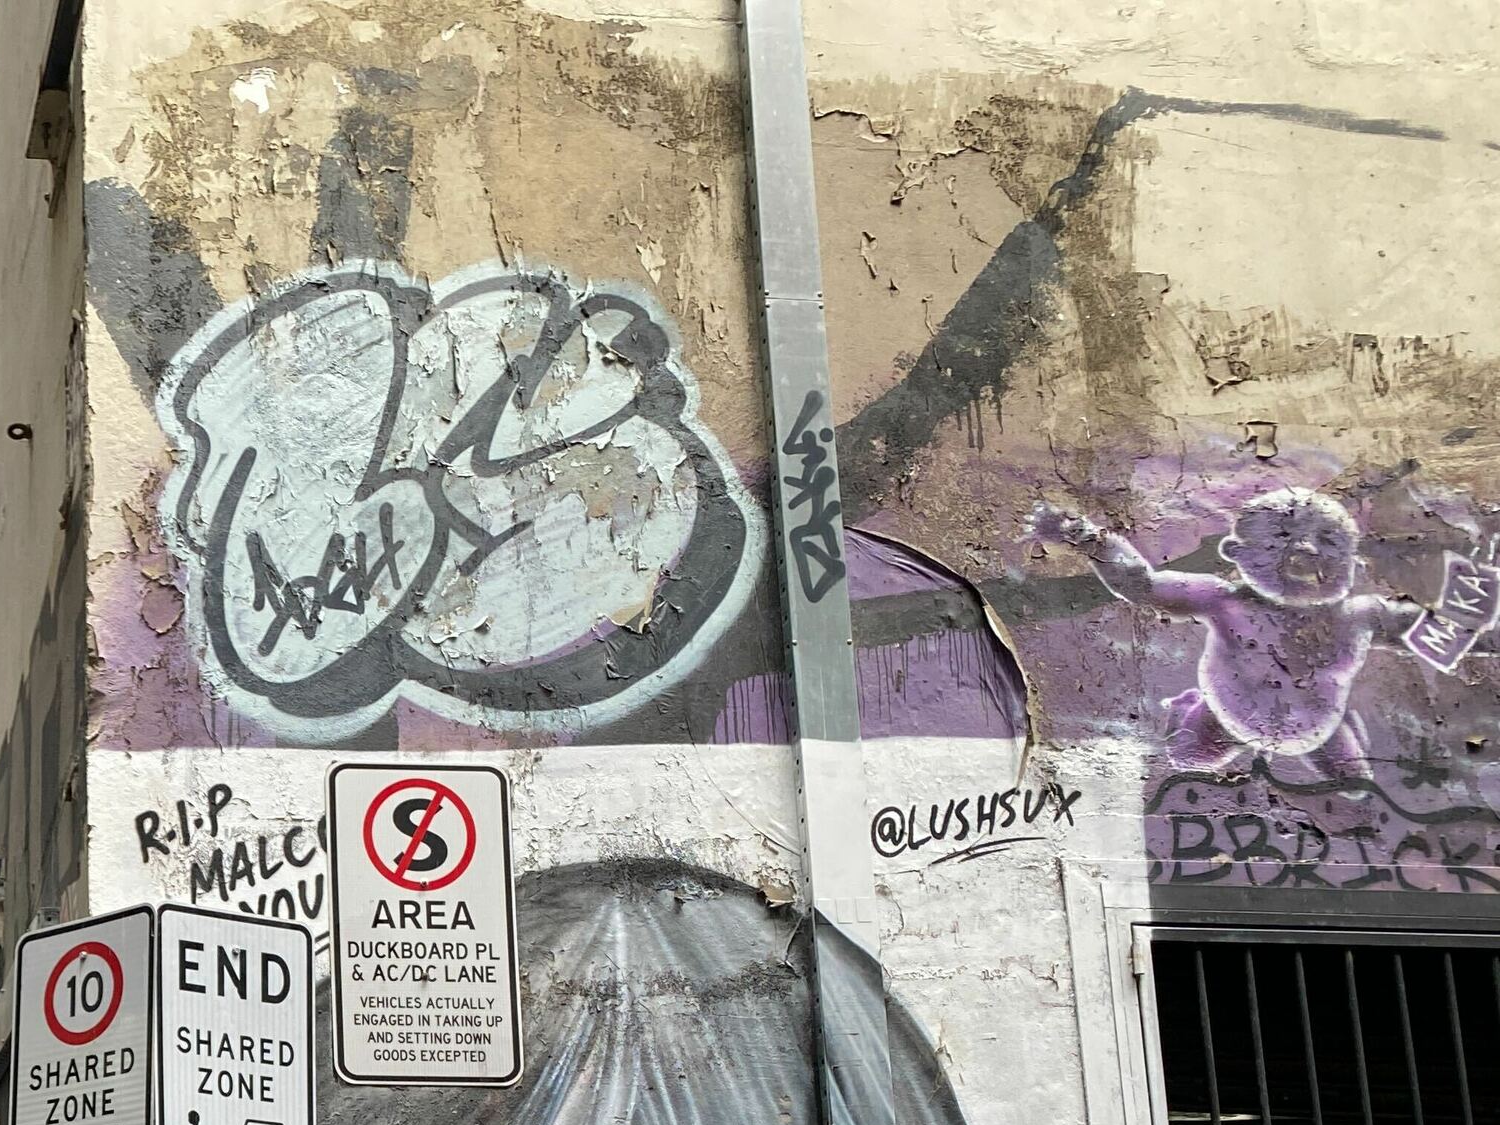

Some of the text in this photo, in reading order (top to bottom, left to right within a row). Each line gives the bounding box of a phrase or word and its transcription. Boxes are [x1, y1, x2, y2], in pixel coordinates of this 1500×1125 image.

[135, 783, 232, 863] R.I.P
[393, 798, 448, 872] S
[871, 783, 1082, 858] @LUSHSUX
[190, 814, 326, 905] MALC
[371, 899, 476, 930] AREA
[347, 941, 501, 960] DUCKBOARD PL
[178, 939, 291, 1004] END
[352, 964, 497, 983] & AC/DC LANE
[66, 971, 104, 1017] 10
[360, 996, 495, 1010] VEHICLES ACTUALLY
[354, 1014, 503, 1027] ENGAGED IN TAKING UP
[367, 1032, 492, 1045] AND SETTING DOWN
[176, 1026, 295, 1067] SHARED
[373, 1049, 487, 1062] GOODS EXCEPTED
[29, 1047, 135, 1091] SHARED
[198, 1067, 275, 1103] ZONE
[45, 1088, 116, 1125] ZONE
